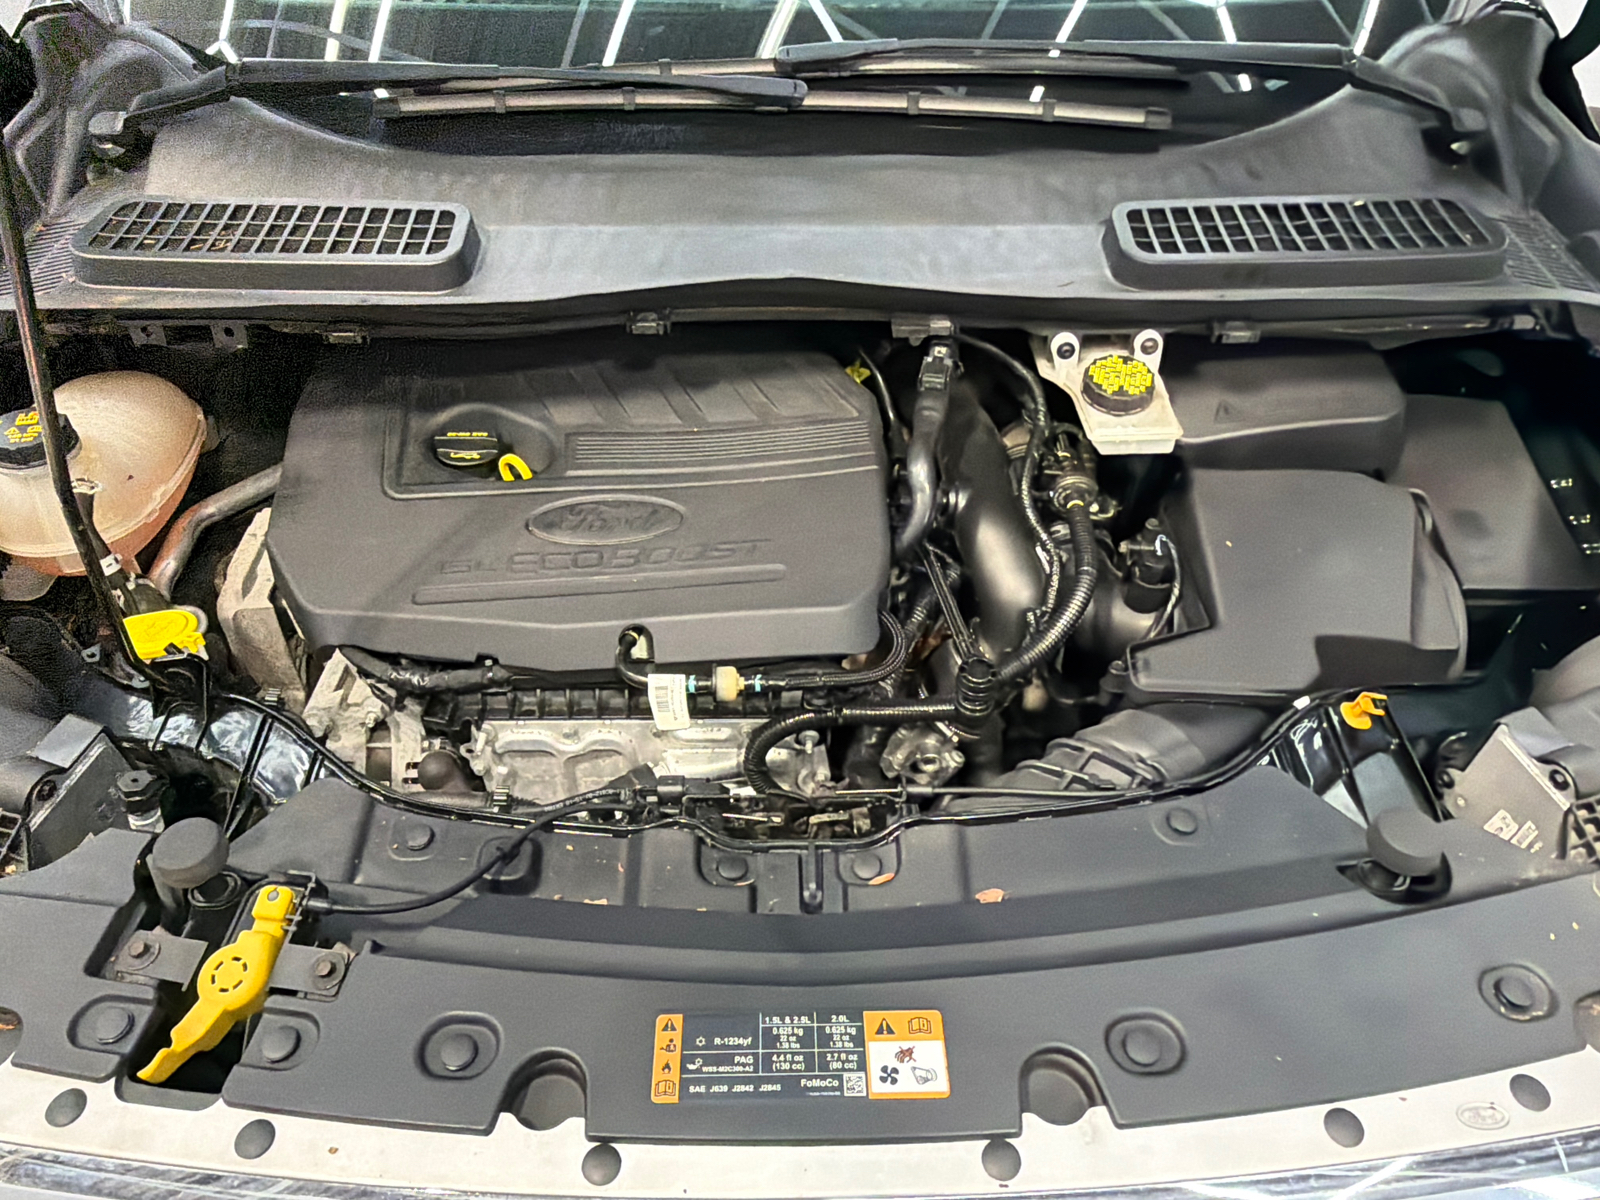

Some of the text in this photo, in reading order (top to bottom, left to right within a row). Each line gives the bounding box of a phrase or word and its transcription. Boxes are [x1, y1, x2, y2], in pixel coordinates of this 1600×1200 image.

[508, 538, 771, 575] ECOBOOST
[764, 1016, 811, 1024] 1.5L & 2.5L
[831, 1015, 850, 1023] 2.0L
[772, 1027, 804, 1036] 0.625 kg
[825, 1026, 856, 1035] 0.625 kg
[714, 1036, 752, 1047] R-1234yf
[734, 1055, 754, 1064] PAG
[786, 1053, 792, 1061] fl
[826, 1053, 838, 1061] 2.7
[772, 1062, 805, 1072] (130 cc)
[829, 1061, 857, 1070] (80 cc)
[800, 1078, 839, 1088] FoMoCo
[689, 1084, 781, 1093] SAE J639 J2842 J2845
